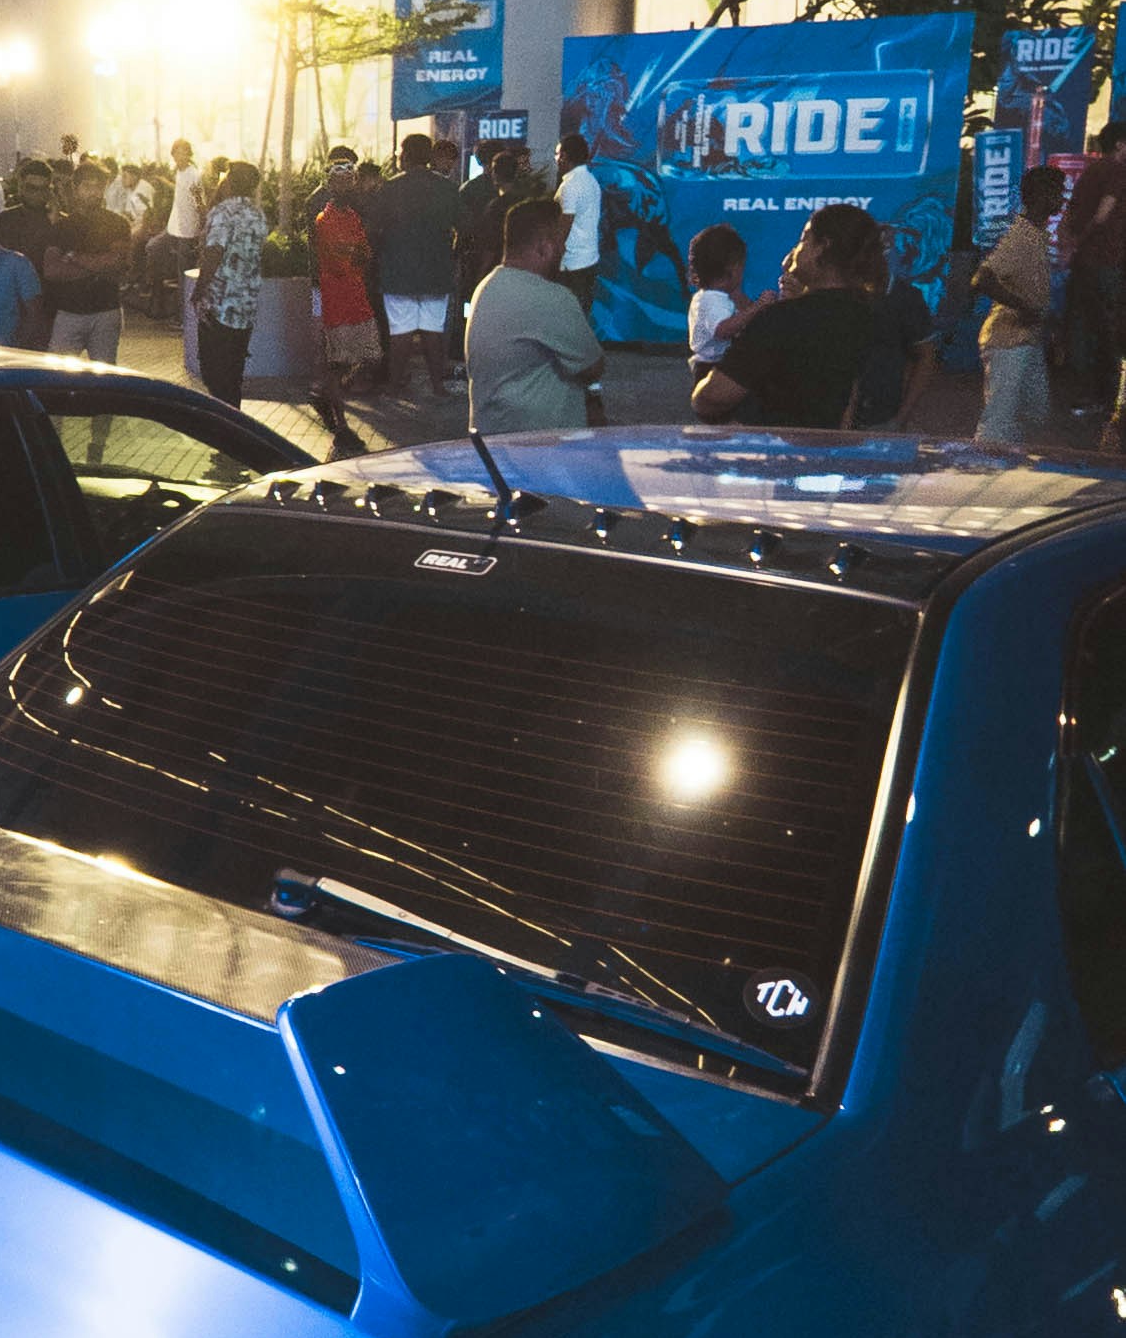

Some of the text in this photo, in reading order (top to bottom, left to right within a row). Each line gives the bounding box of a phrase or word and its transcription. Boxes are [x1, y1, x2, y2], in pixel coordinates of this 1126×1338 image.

[428, 49, 478, 63] REAL
[1016, 37, 1077, 63] RIDE
[415, 67, 488, 82] ENERGY
[478, 117, 525, 139] RIDE
[725, 97, 890, 156] RIDE
[983, 146, 1012, 217] RIDE
[723, 197, 780, 211] REAL
[421, 553, 469, 569] REAL
